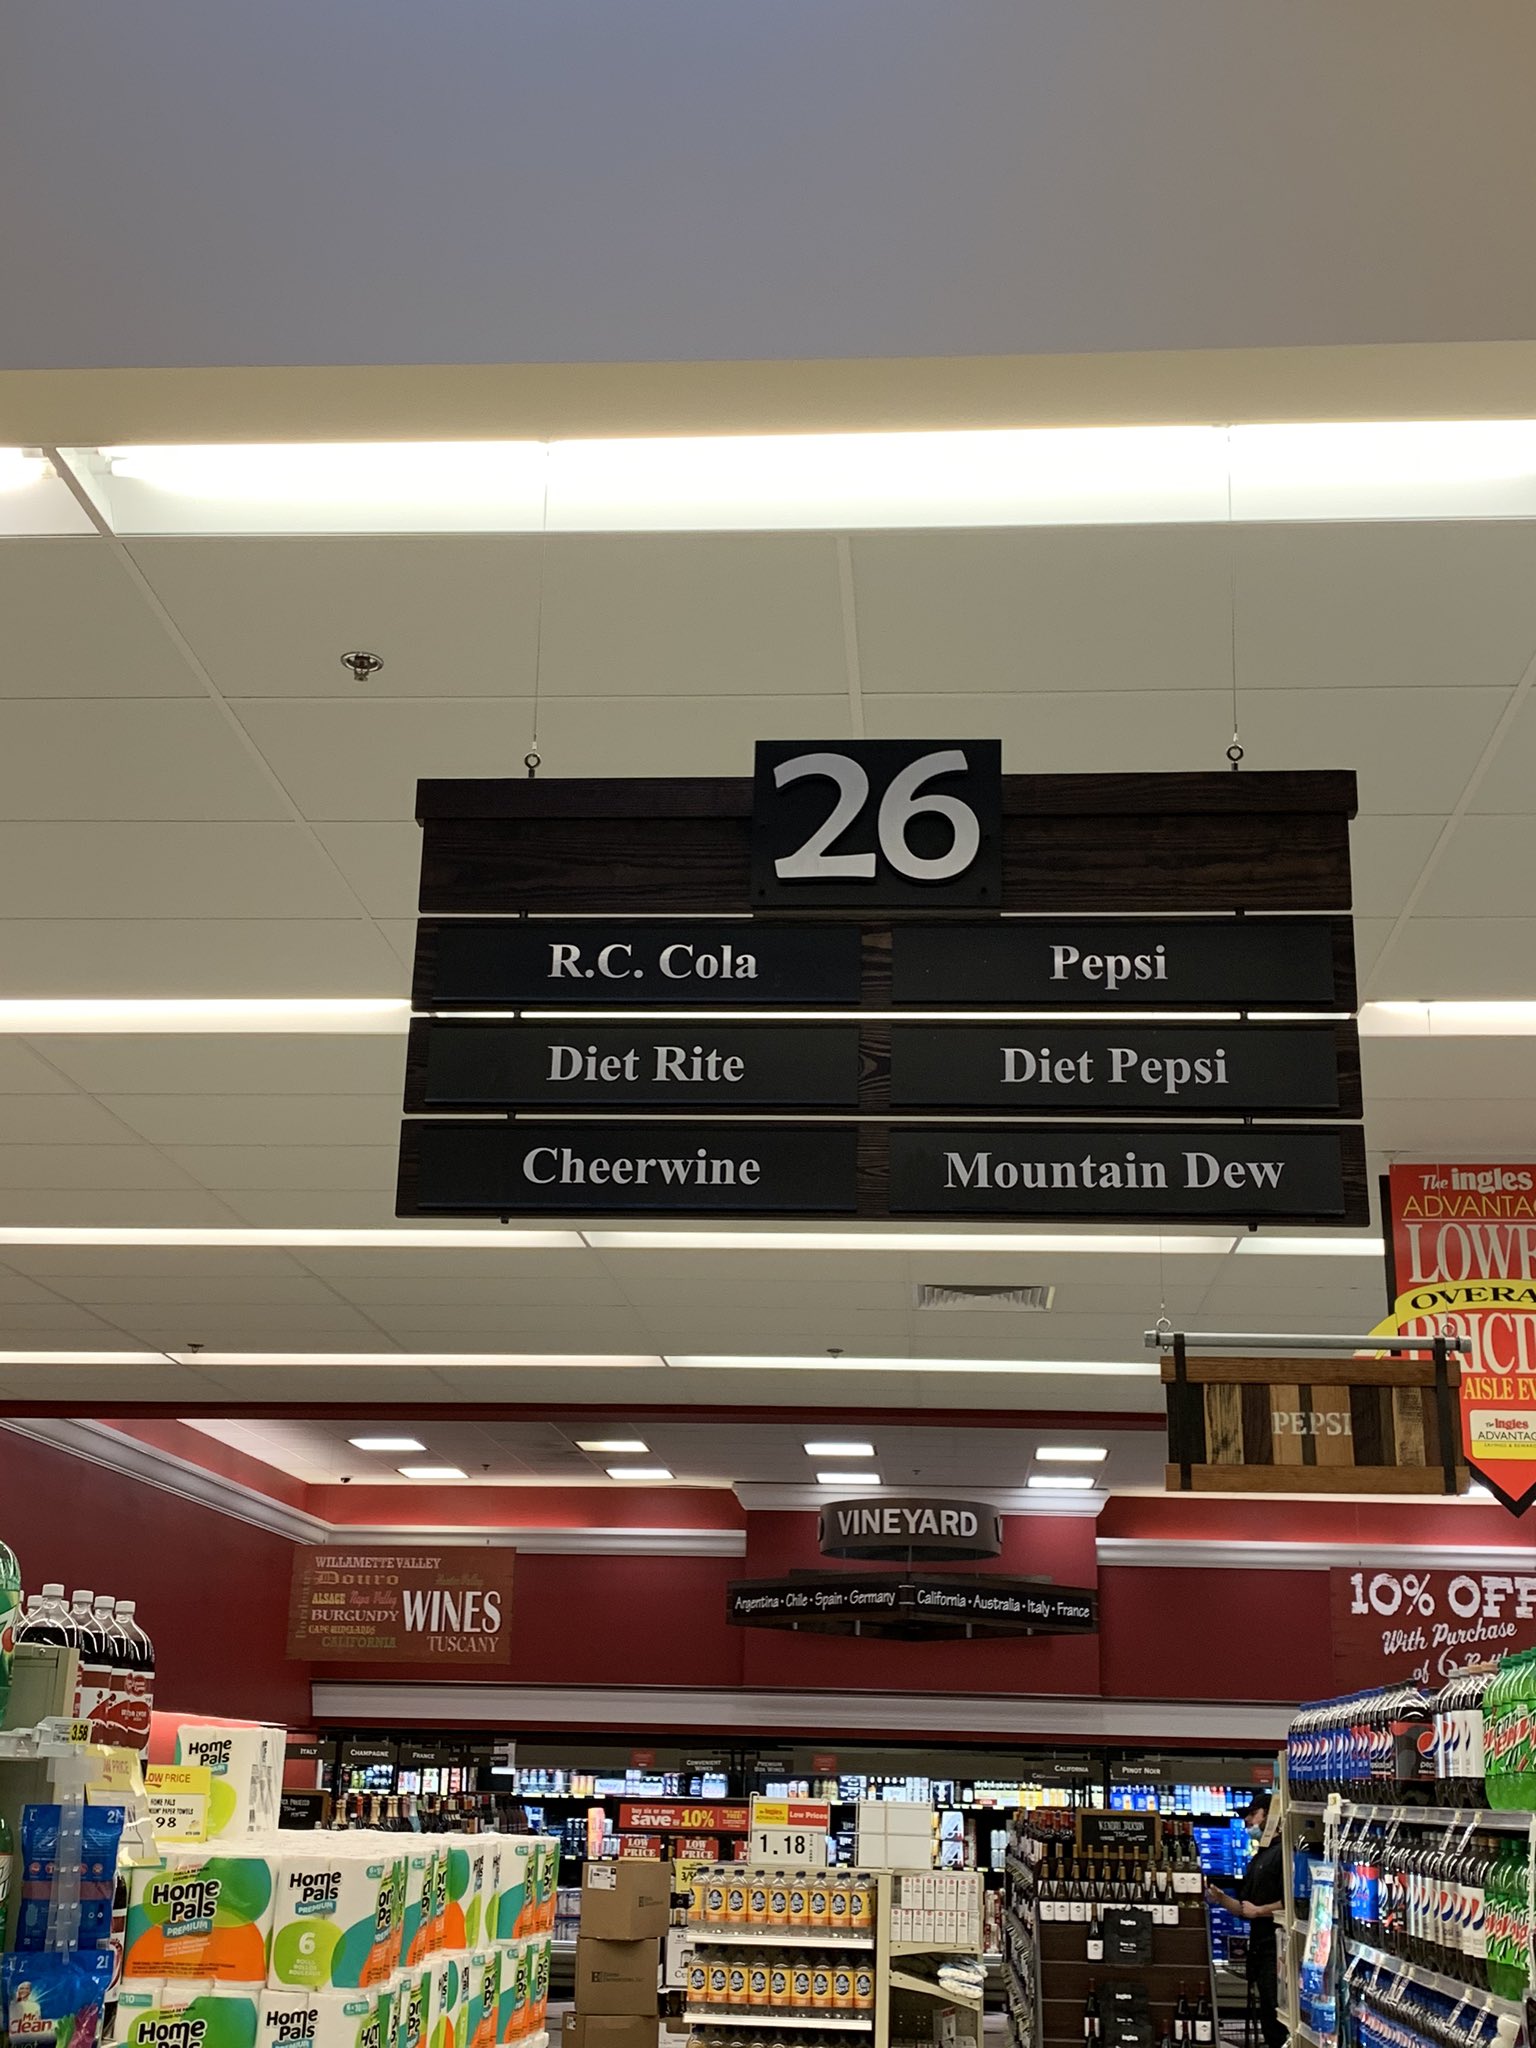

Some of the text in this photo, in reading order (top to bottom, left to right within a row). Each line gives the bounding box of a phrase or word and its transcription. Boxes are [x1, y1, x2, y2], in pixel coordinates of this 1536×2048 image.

[773, 750, 981, 882] 26
[547, 943, 759, 982] R.C. Cola
[1049, 944, 1168, 991] Pepsi
[546, 1045, 745, 1084] Diet Rite
[1001, 1046, 1229, 1095] Diet Pepsi
[522, 1147, 761, 1188] Cheerwine
[944, 1150, 1286, 1191] Mountain Dew
[1419, 1167, 1533, 1194] The ingles
[1403, 1195, 1536, 1217] ADVANTA
[1463, 1376, 1515, 1400] AISLE
[1272, 1411, 1353, 1436] PEPSI
[837, 1507, 979, 1538] VINEYARD
[315, 1556, 442, 1569] WILLAMETTE VALLEY
[314, 1570, 399, 1586] Douro
[735, 1590, 896, 1612] Argentina Chile Spain Germany
[916, 1590, 1091, 1618] California Australia Italy France
[1350, 1572, 1536, 1619] 10% OFF
[311, 1609, 400, 1622] BURGUNDY
[402, 1590, 502, 1634] WINES
[427, 1635, 499, 1653] TUSCANY
[1381, 1616, 1518, 1656] With Purchase
[1412, 1658, 1430, 1684] of
[1437, 1646, 1459, 1678] 6
[71, 1725, 88, 1743] 3.58
[188, 1739, 233, 1755] Home
[200, 1750, 230, 1766] Pals
[165, 1774, 191, 1784] PRICE
[155, 1816, 177, 1829] 98
[630, 1813, 672, 1826] save
[681, 1809, 715, 1828] 10%
[805, 1811, 828, 1820] Prices
[623, 1848, 656, 1858] PRICE
[627, 1838, 649, 1849] LOW
[685, 1839, 707, 1850] LOW
[760, 1834, 806, 1855] 1.18
[681, 1849, 714, 1860] PRICE
[289, 1871, 342, 1888] Home
[152, 1880, 220, 1904] Home
[302, 1885, 339, 1902] Pals
[171, 1899, 216, 1921] Pals
[298, 1902, 334, 1914] PREMIUM
[166, 1920, 208, 1937] PREMIUM
[299, 1932, 316, 1954] 6
[10, 2019, 53, 2034] Clean
[23, 2012, 37, 2021] Mr.
[266, 2008, 318, 2026] Home
[138, 2020, 206, 2043] Home
[279, 2023, 315, 2041] Pals
